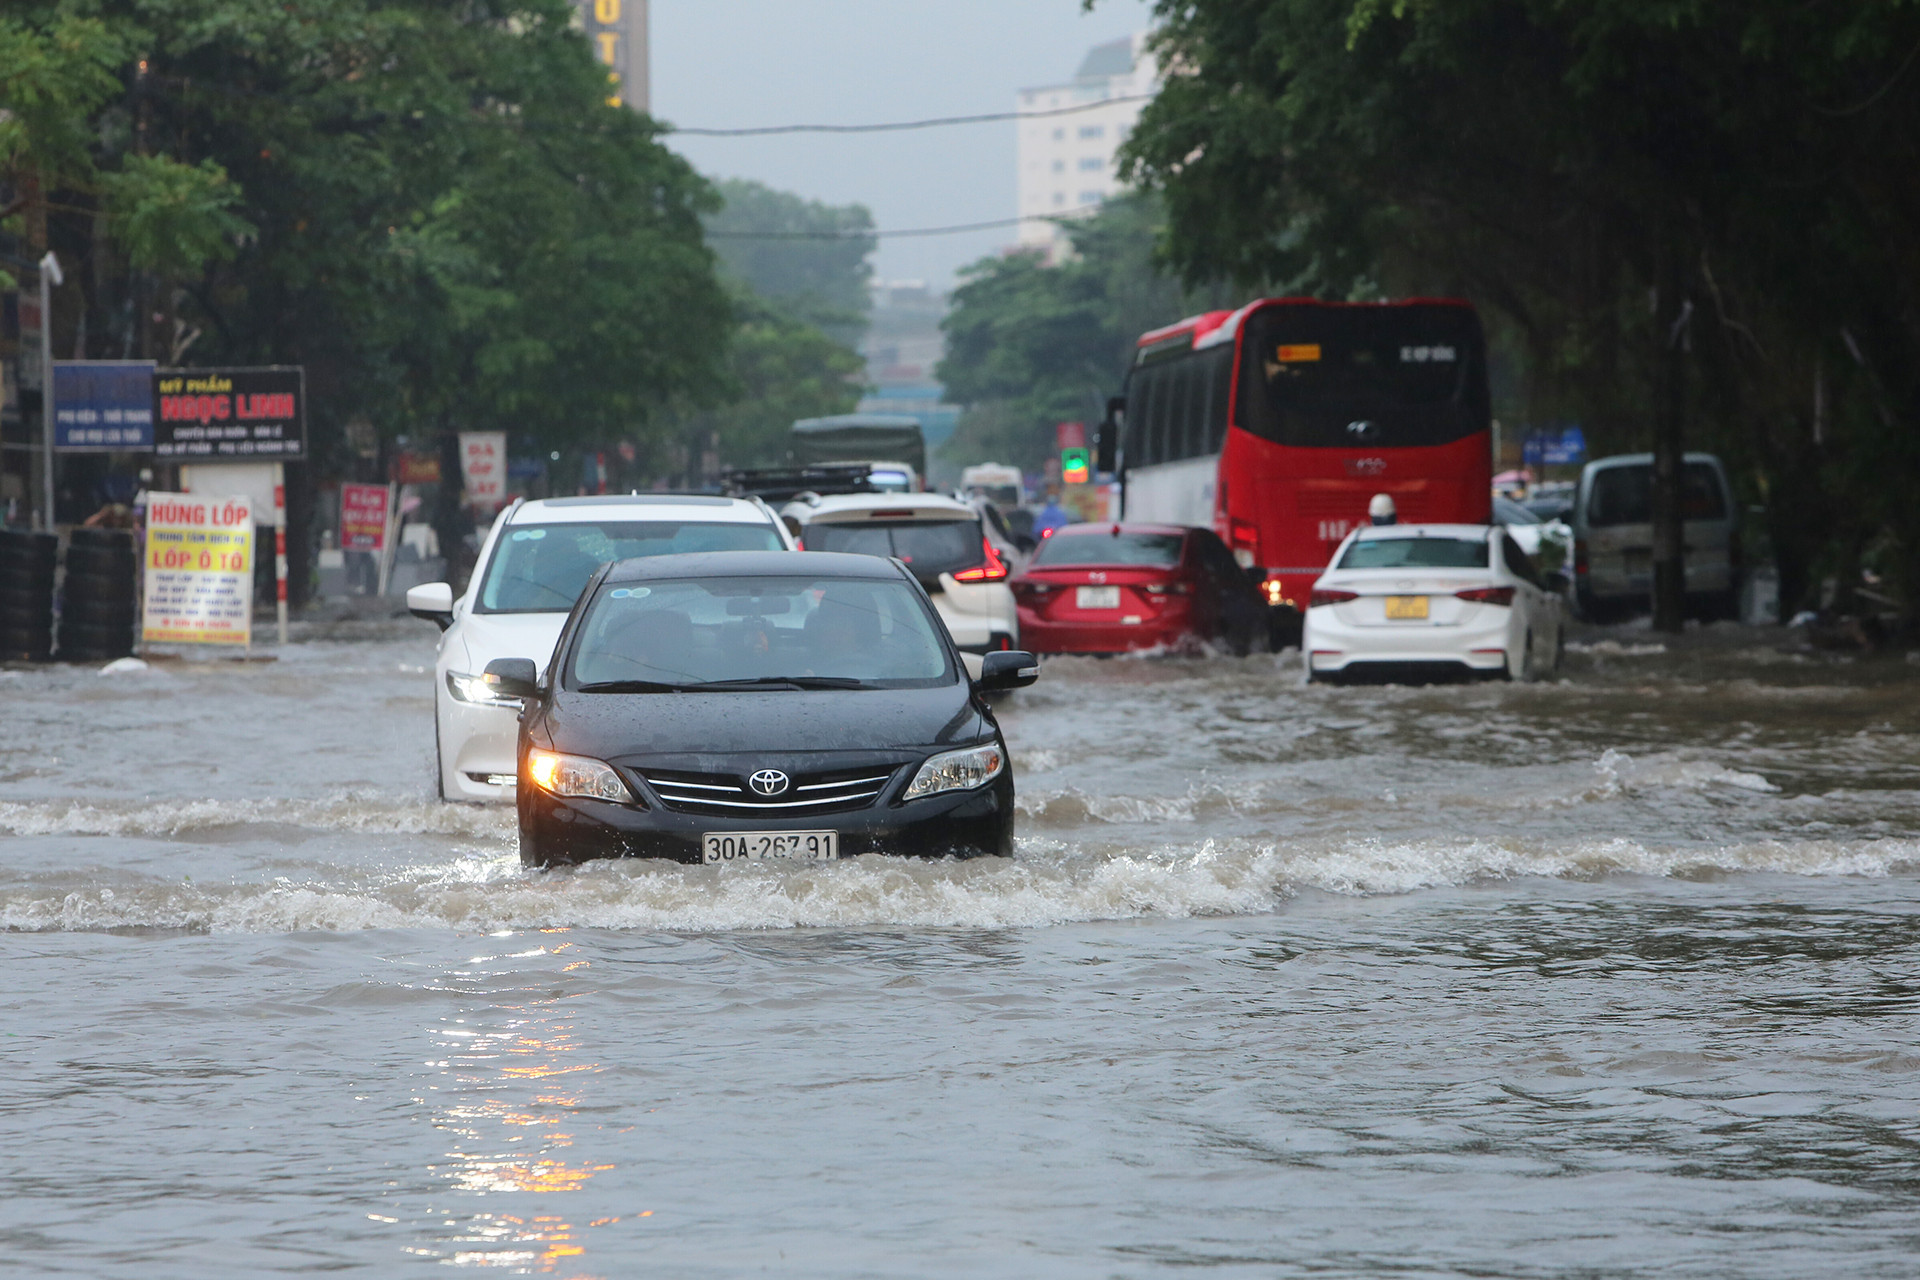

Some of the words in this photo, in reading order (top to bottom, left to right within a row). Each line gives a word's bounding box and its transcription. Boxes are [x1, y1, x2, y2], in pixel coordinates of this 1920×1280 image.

[159, 377, 183, 393] MỸ
[186, 374, 233, 393] PHẨM
[160, 394, 230, 425] NGỌC
[236, 393, 294, 419] LINH
[152, 545, 191, 569] LỐP
[199, 549, 211, 570] Ô
[221, 551, 243, 570] TÔ
